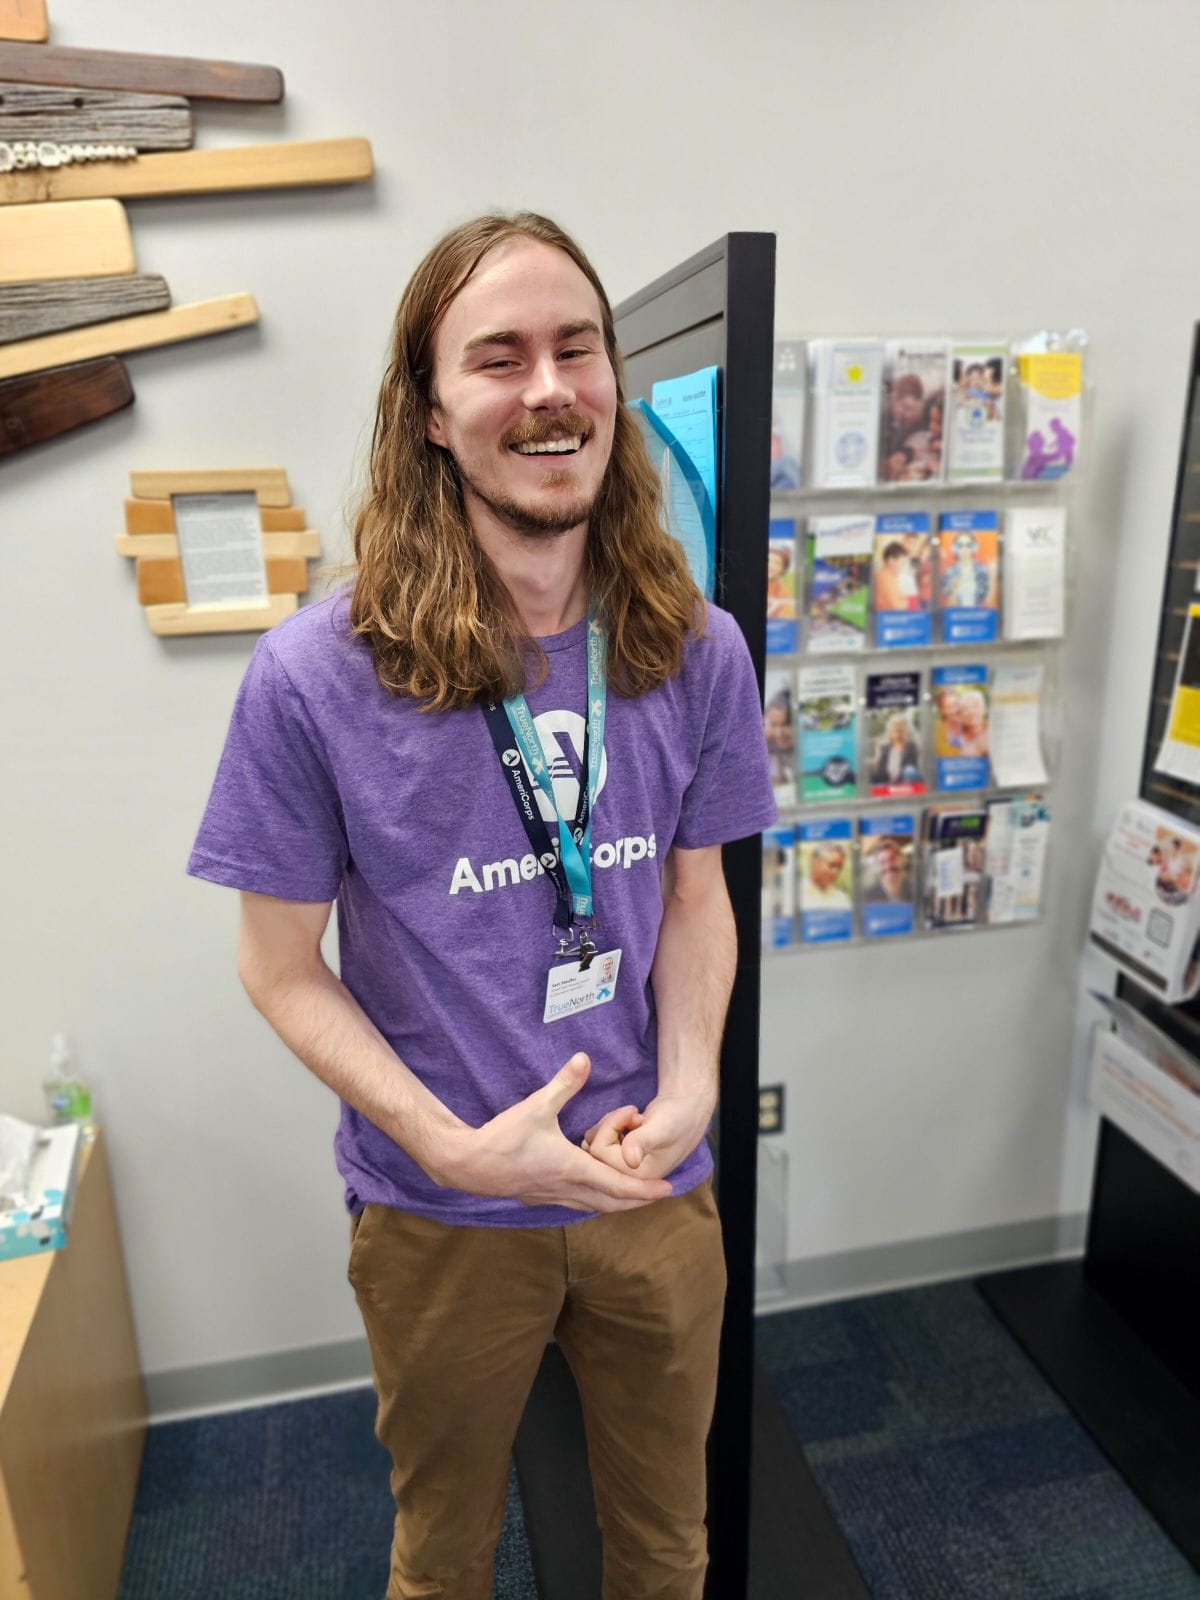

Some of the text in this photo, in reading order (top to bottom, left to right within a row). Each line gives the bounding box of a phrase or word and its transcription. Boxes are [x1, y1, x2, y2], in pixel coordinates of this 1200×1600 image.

[516, 703, 540, 755] TrueNorth
[591, 719, 599, 768] TrueNorth
[511, 770, 535, 820] AmeriCorps
[578, 782, 590, 824] AmeriCo
[449, 833, 656, 895] Ameiorps
[549, 992, 594, 1013] TrueNorth
